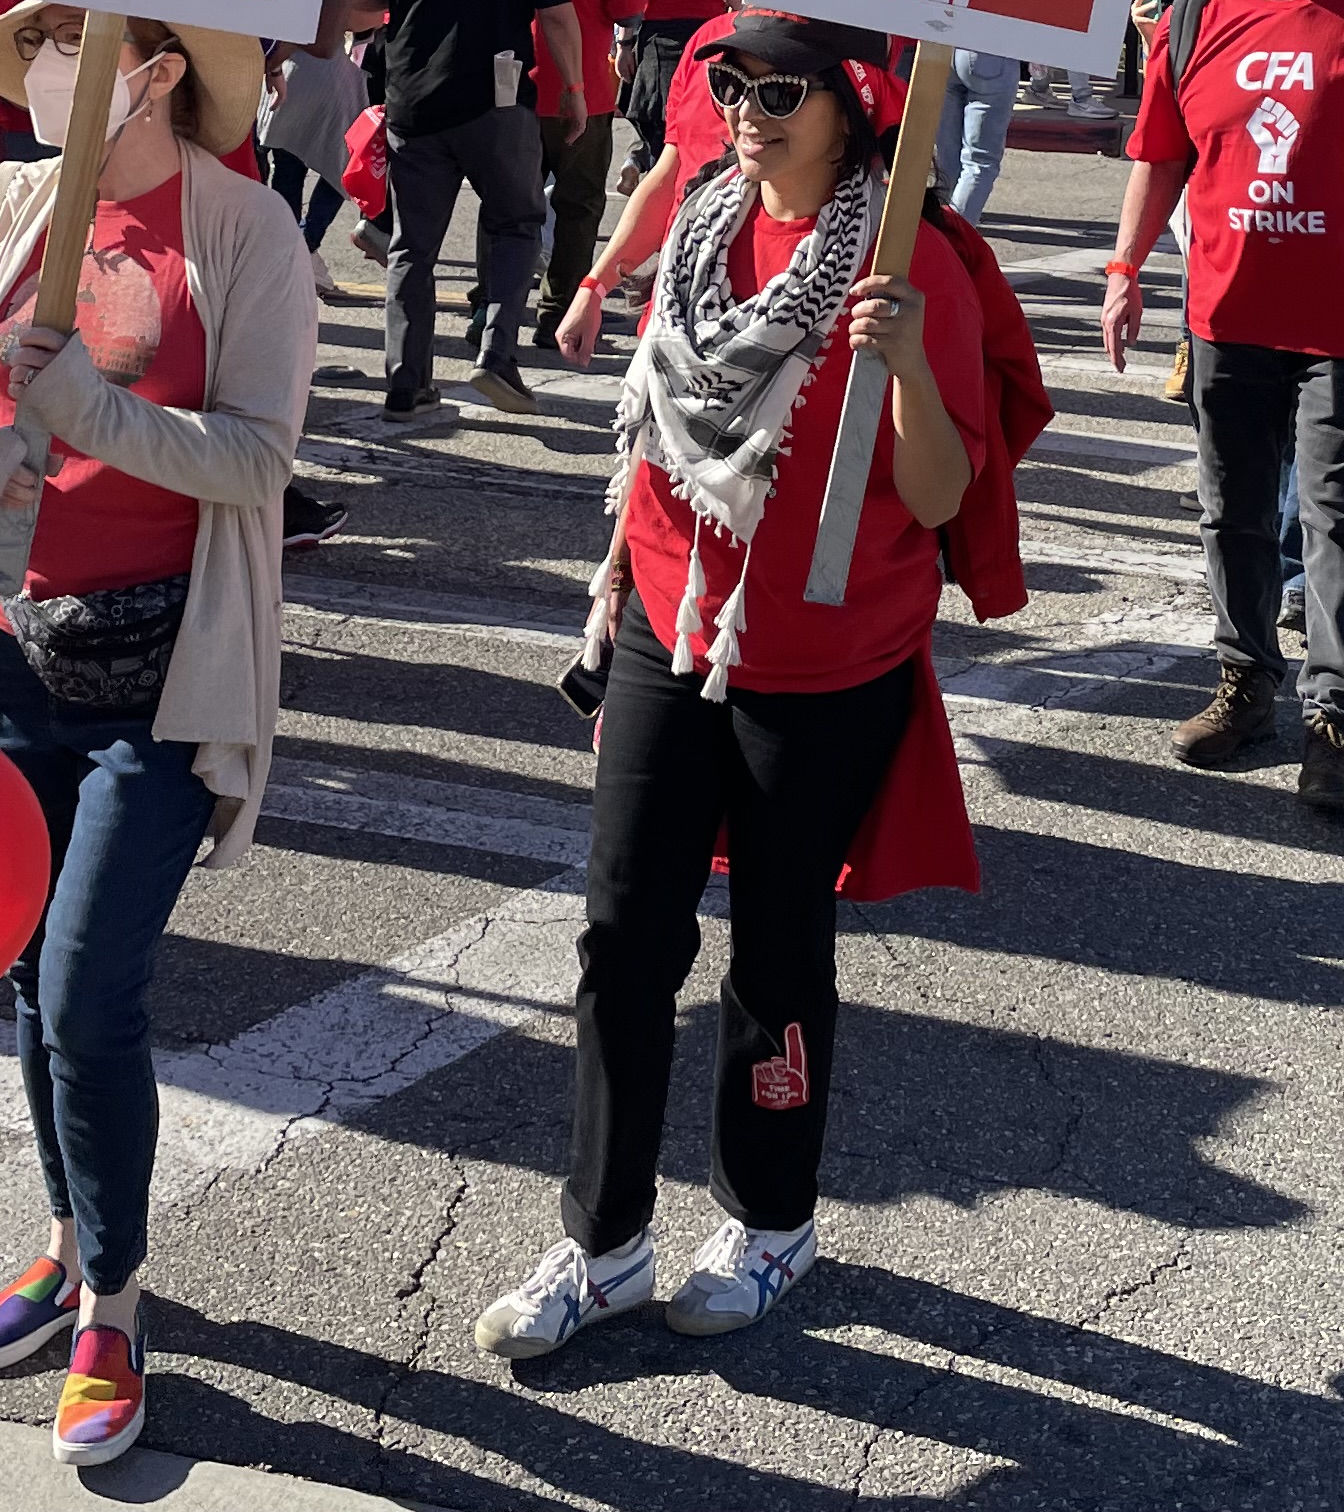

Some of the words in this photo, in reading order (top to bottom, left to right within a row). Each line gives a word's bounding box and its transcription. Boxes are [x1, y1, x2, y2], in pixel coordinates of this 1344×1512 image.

[1236, 52, 1315, 91] CFA
[1248, 180, 1295, 205] ON
[1228, 207, 1326, 234] STRIKE
